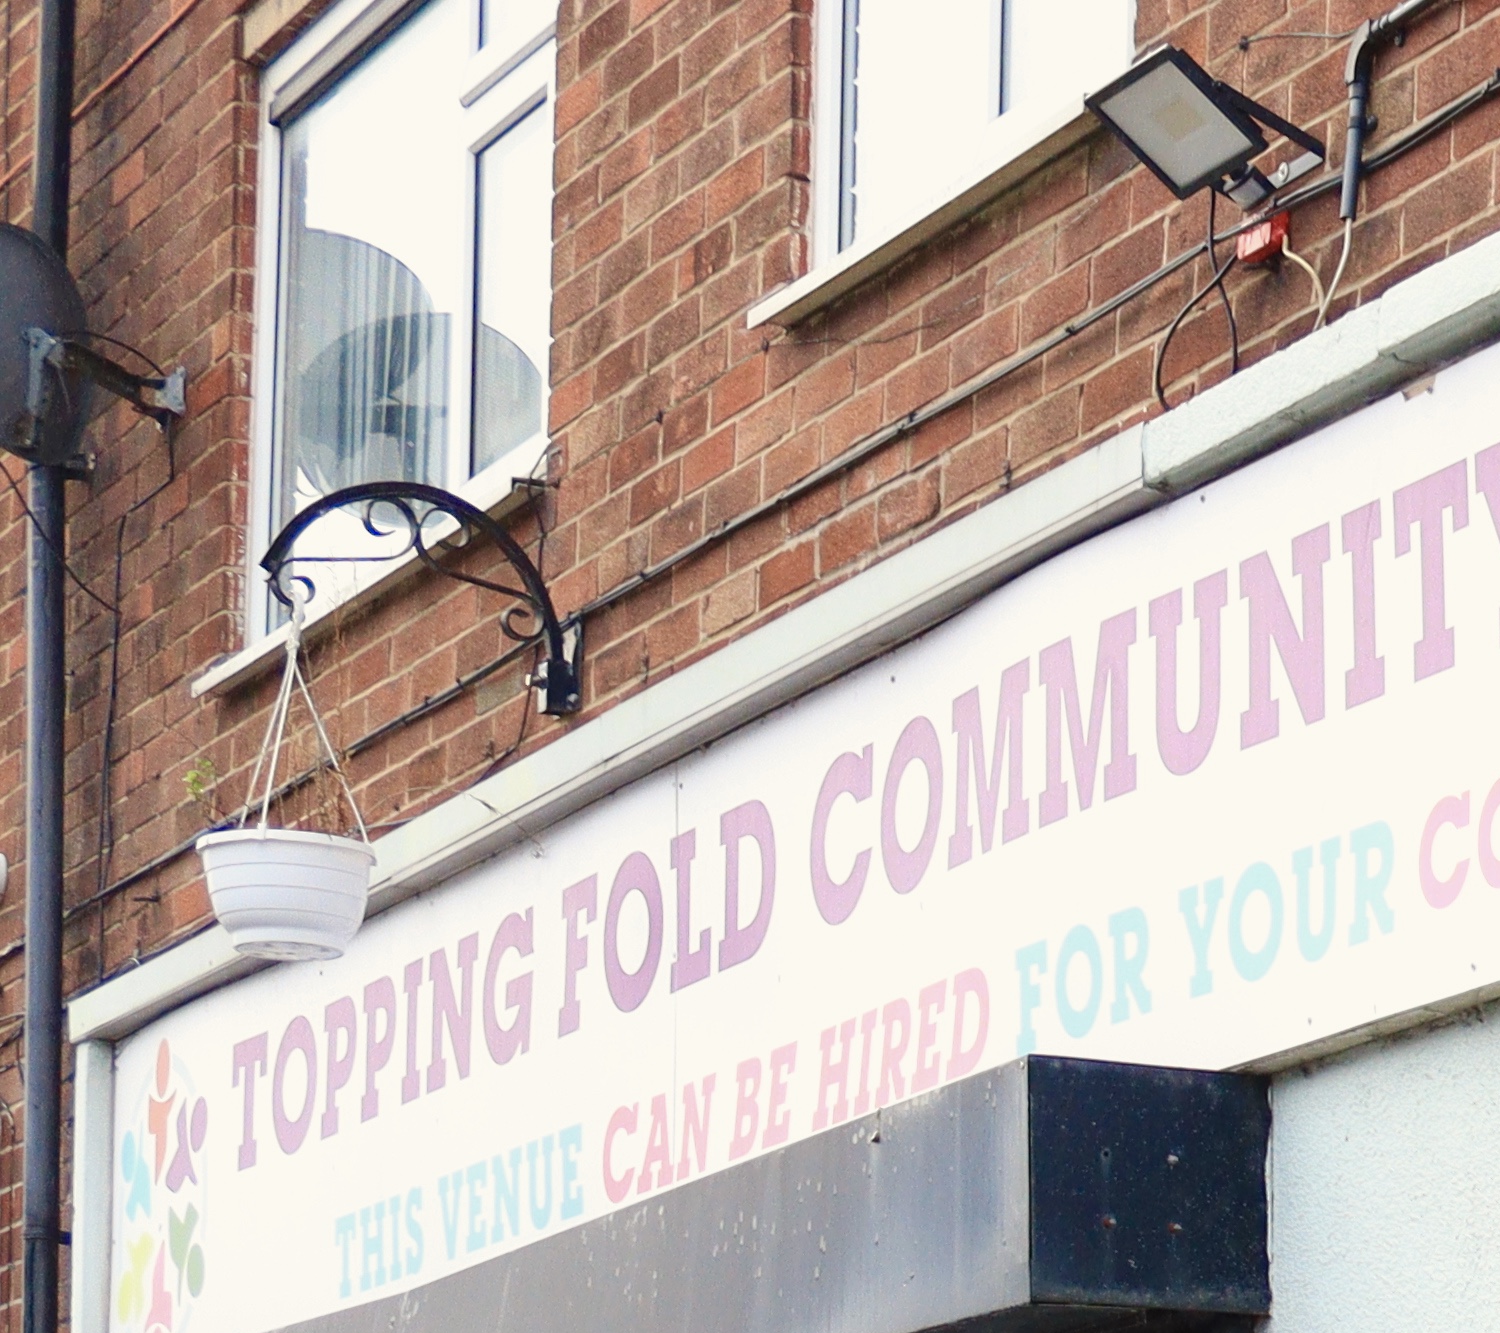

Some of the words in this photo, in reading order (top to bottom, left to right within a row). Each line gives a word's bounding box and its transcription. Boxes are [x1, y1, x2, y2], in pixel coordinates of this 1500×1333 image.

[232, 905, 535, 1172] TOPPING
[558, 799, 777, 1039] FOLD
[335, 1187, 426, 1300] THIS
[439, 1123, 585, 1262] VENUE
[602, 1076, 711, 1206] CAN
[730, 1041, 799, 1163] BE
[812, 967, 990, 1132] HIRED
[1016, 907, 1152, 1054] FOR
[1180, 820, 1394, 1000] YOUR
